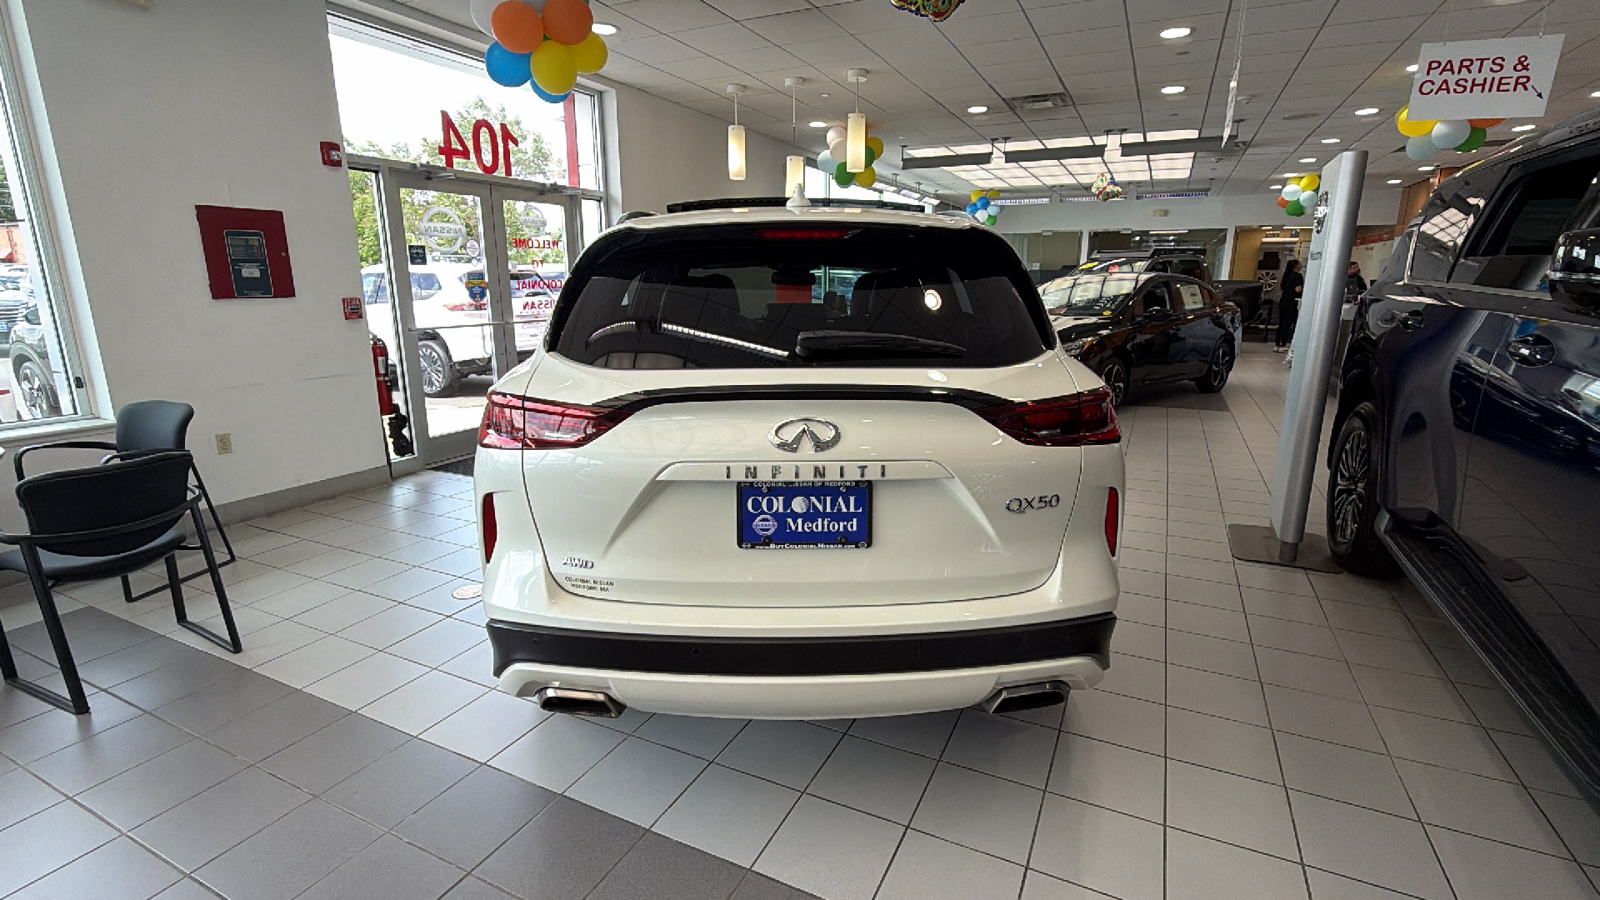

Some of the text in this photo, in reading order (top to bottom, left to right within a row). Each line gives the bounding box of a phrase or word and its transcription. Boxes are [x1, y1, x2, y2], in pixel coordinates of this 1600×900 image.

[1426, 54, 1530, 76] PARTS &
[1418, 75, 1531, 96] CASHIER
[726, 464, 886, 479] INFINITI
[747, 496, 862, 513] COLONIAL
[1005, 493, 1060, 513] QX50
[786, 517, 858, 533] Medford
[562, 557, 594, 569] AWD
